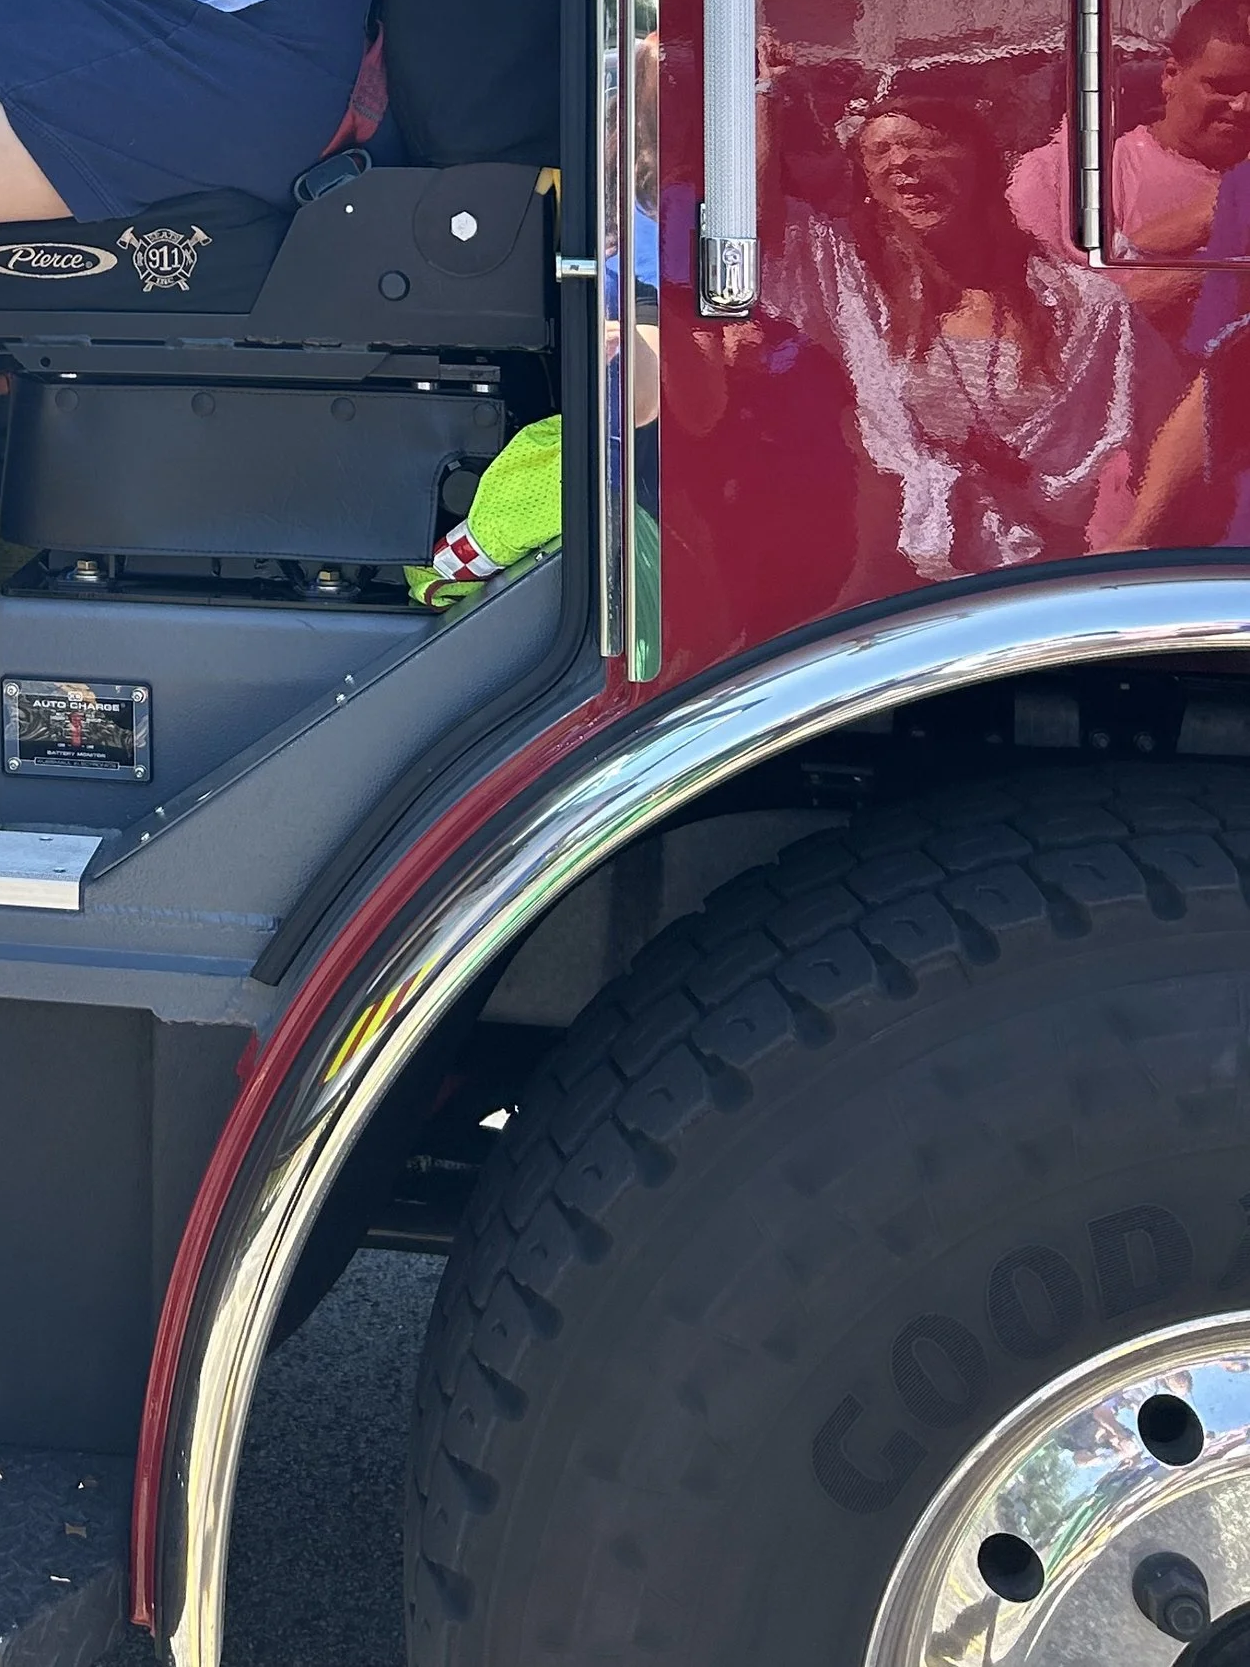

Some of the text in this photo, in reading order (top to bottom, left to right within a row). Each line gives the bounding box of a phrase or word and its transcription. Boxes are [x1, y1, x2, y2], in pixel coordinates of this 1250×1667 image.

[7, 246, 85, 270] Pierce
[148, 245, 181, 271] 911
[33, 700, 120, 712] AUTO CHARGE
[811, 1202, 1195, 1515] GOOD
